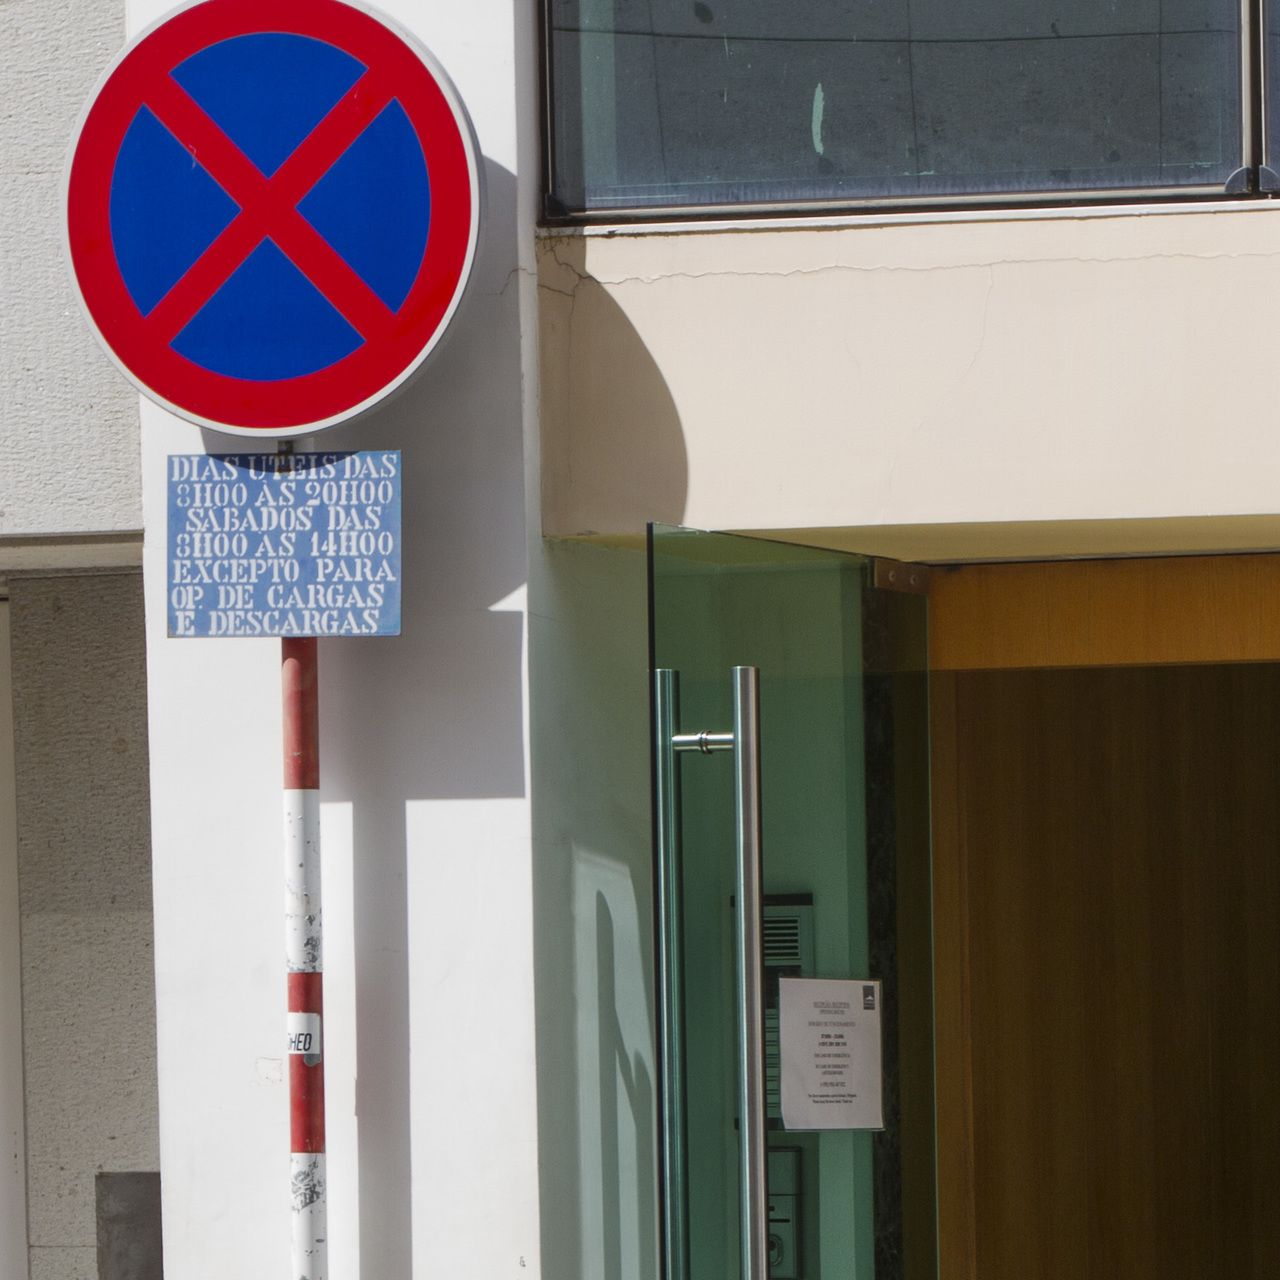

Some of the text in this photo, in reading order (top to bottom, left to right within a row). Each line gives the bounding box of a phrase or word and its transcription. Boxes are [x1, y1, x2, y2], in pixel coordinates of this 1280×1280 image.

[172, 456, 239, 481] DIAS
[344, 453, 397, 480] DAS
[255, 480, 296, 507] ÀS
[328, 506, 381, 531] DAS
[173, 558, 396, 583] EXCEPTO PARA
[171, 583, 385, 609] OP. DE CARGAS
[175, 609, 380, 635] E DESCARGAS
